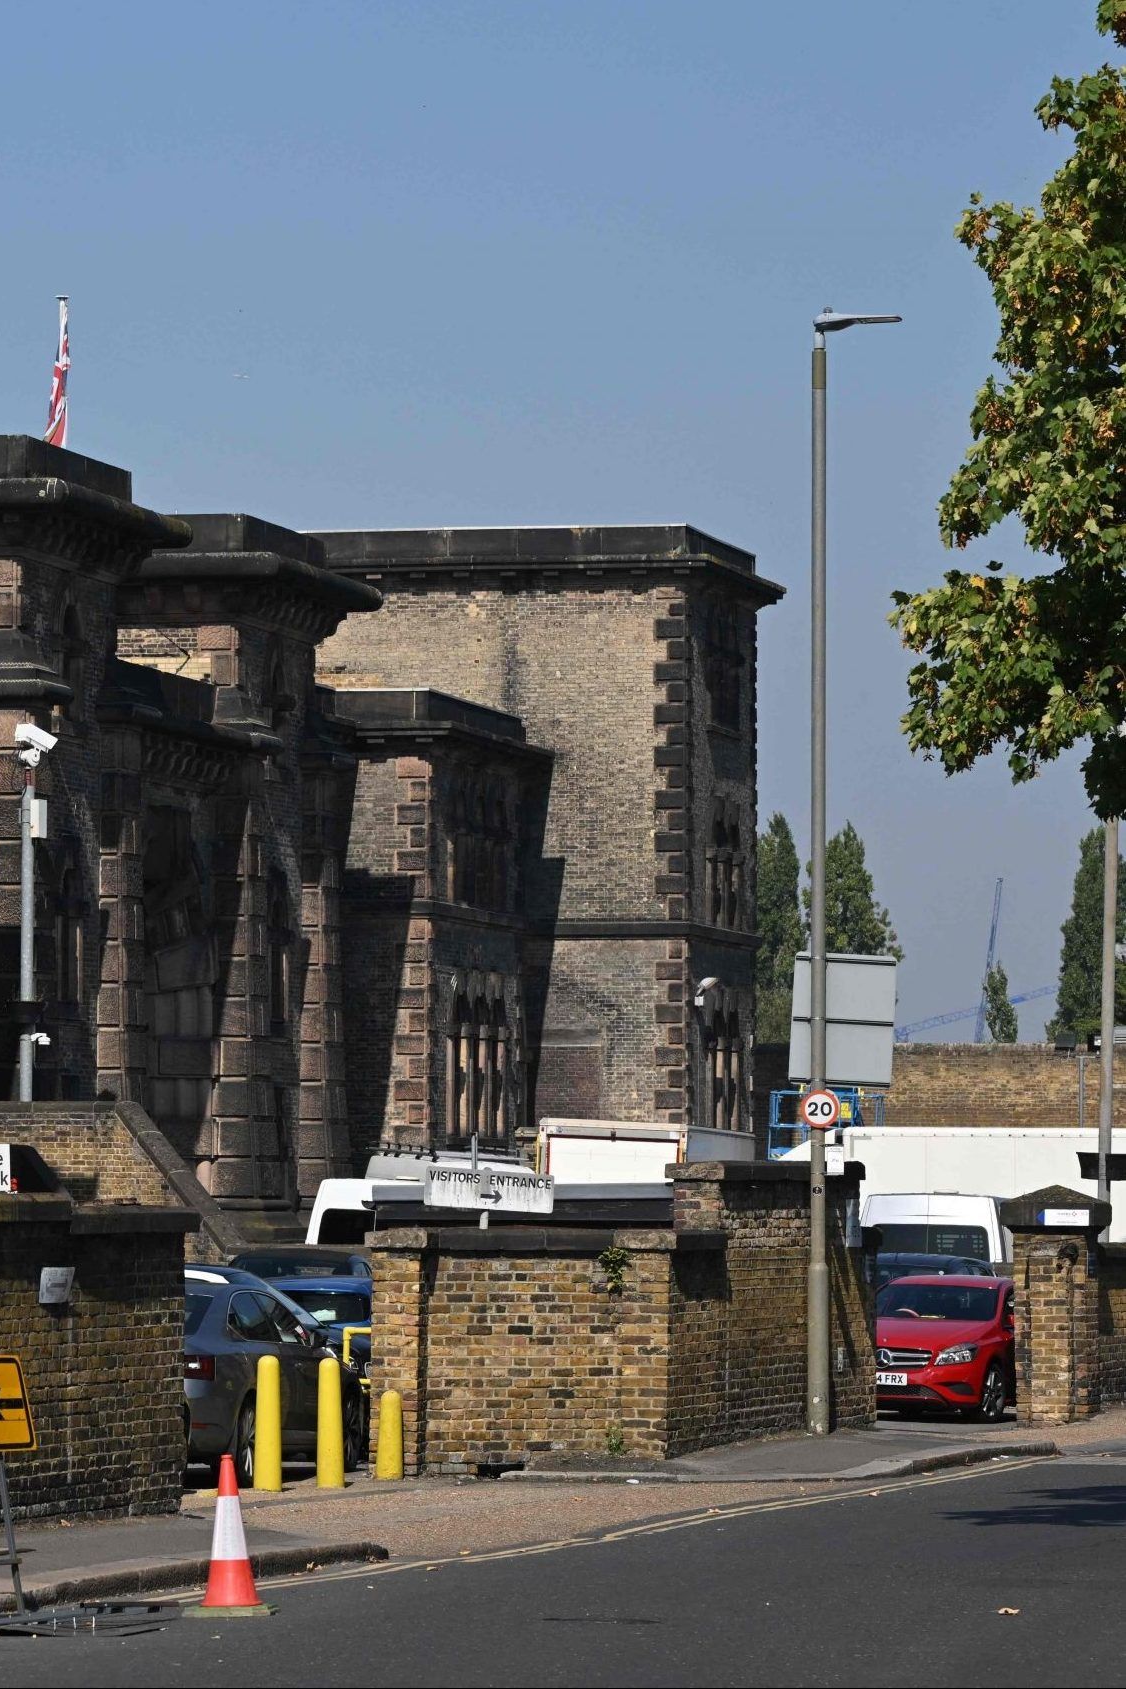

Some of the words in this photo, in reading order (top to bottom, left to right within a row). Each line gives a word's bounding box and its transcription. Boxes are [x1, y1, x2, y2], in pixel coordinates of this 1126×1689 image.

[807, 1101, 833, 1117] 20
[429, 1170, 481, 1184] VISITORS
[489, 1175, 552, 1190] ENTRANCE
[884, 1374, 904, 1384] FRX
